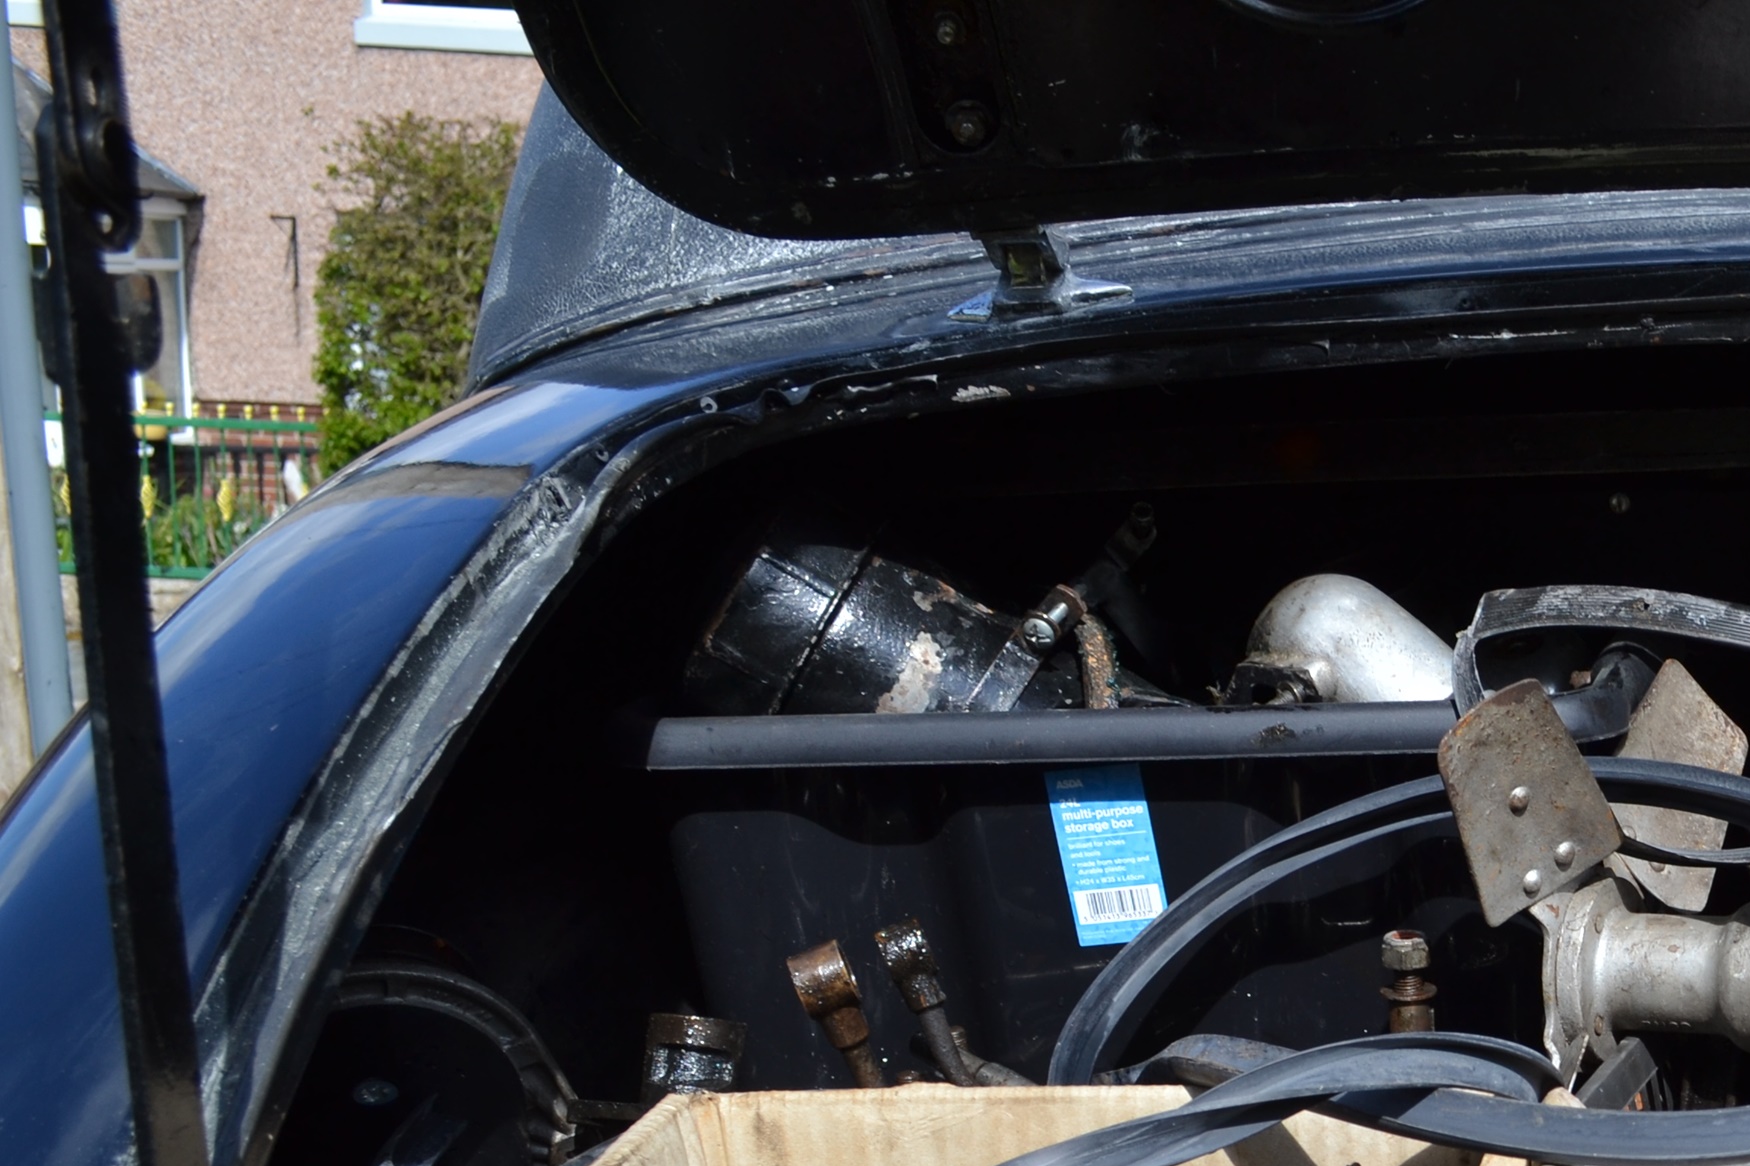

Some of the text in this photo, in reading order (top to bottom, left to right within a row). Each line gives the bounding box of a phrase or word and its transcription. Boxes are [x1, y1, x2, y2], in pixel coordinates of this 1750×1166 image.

[1056, 779, 1084, 789] ASDA
[1059, 797, 1081, 809] 24L
[1062, 805, 1144, 820] multi-purpose
[1064, 818, 1134, 833] storage box
[1068, 841, 1093, 850] brilliant
[1104, 839, 1126, 847] shoes
[1070, 851, 1083, 859] and
[1114, 857, 1136, 865] strong
[1137, 854, 1150, 862] and
[1104, 865, 1127, 874] plastic
